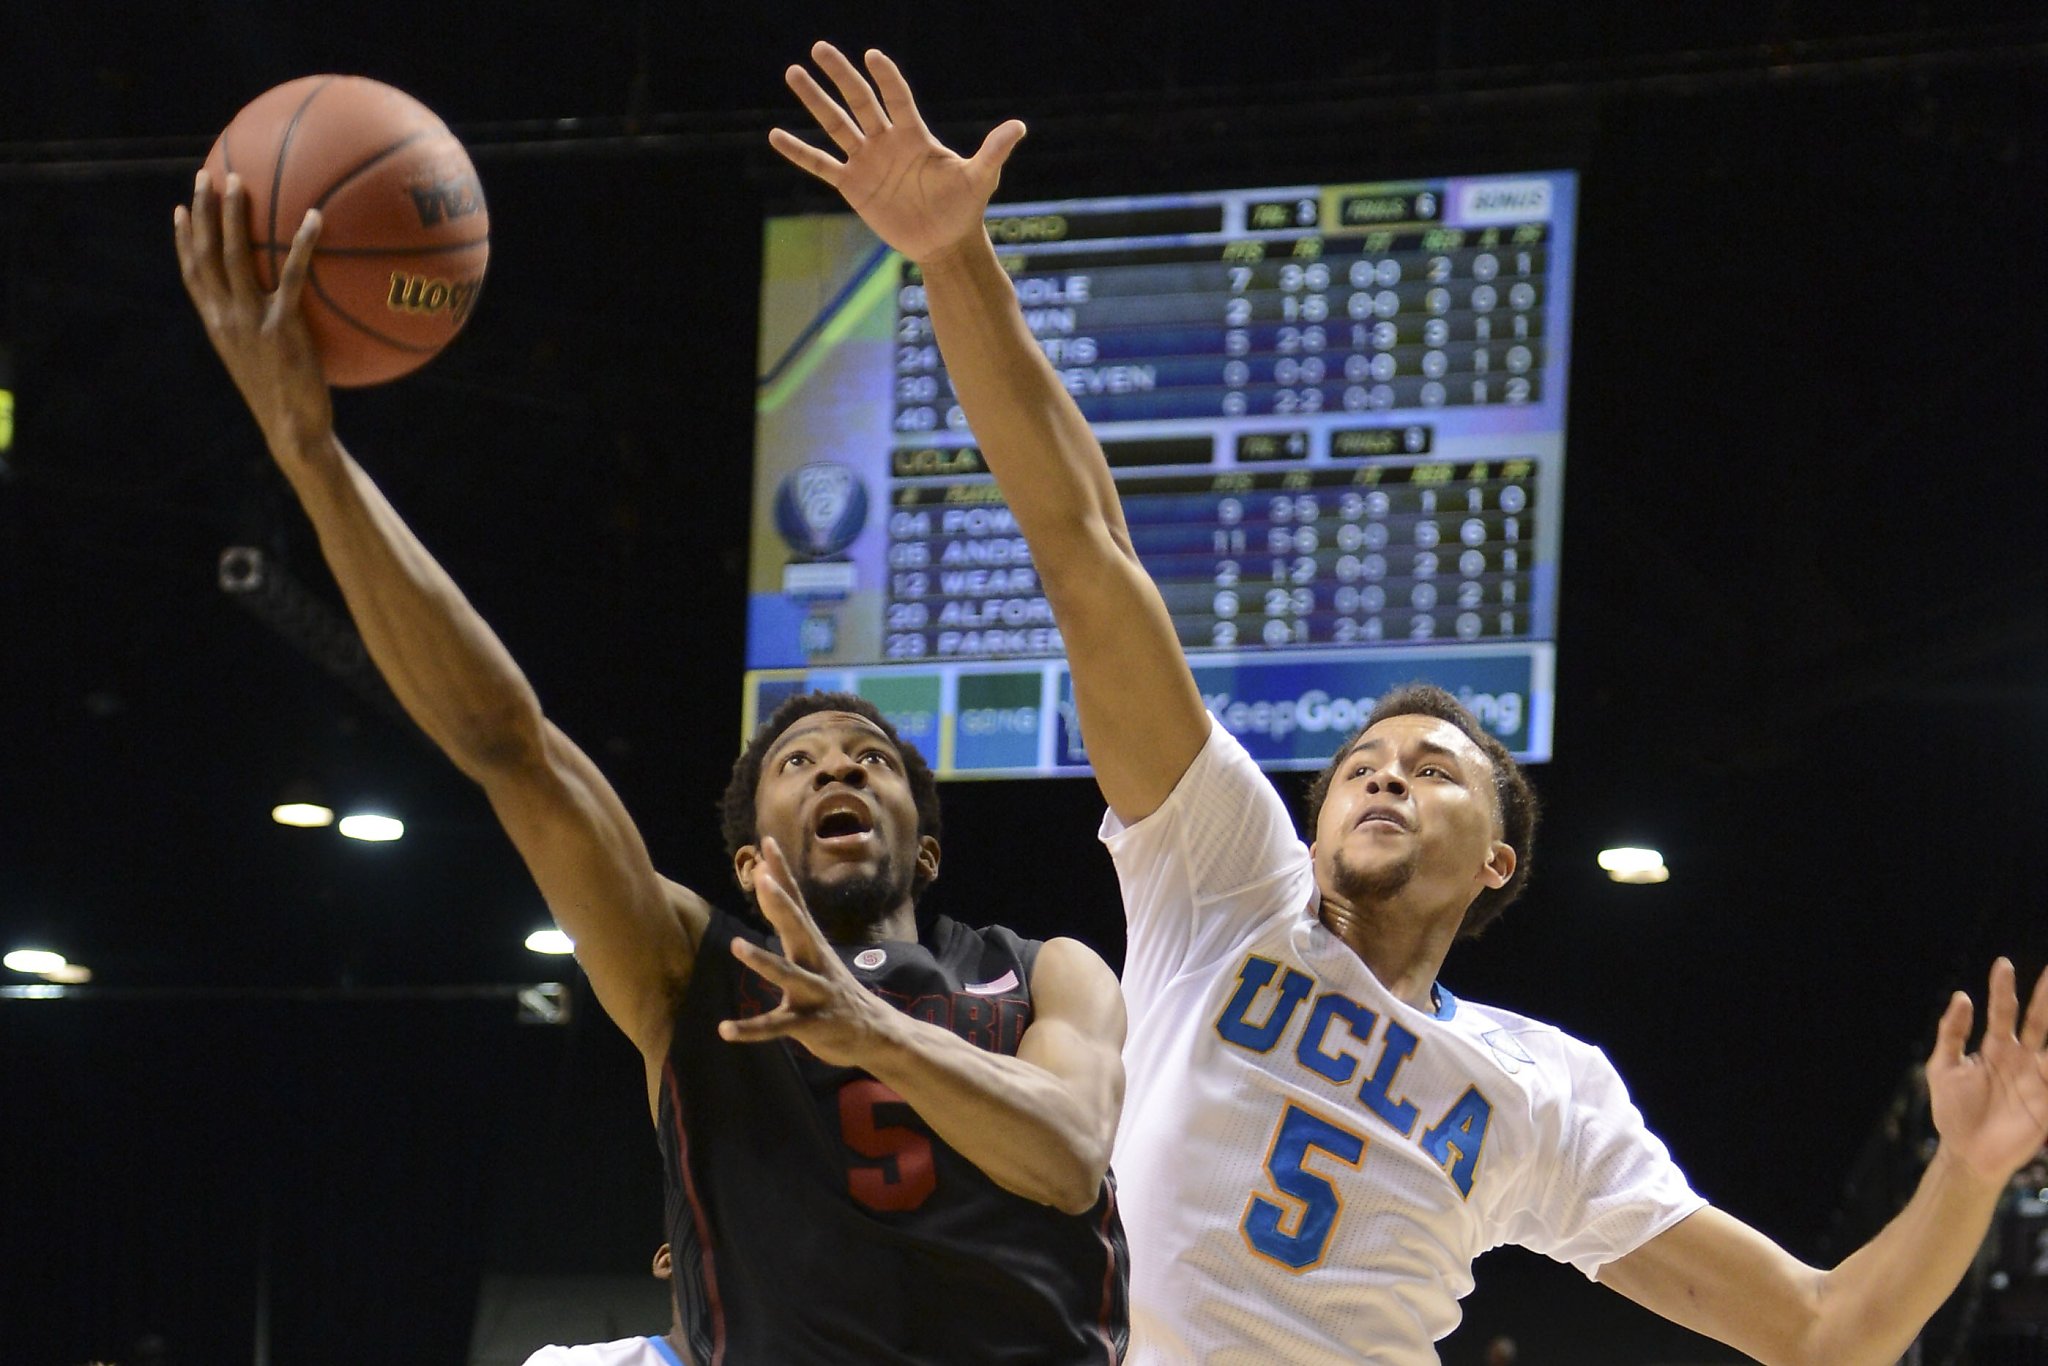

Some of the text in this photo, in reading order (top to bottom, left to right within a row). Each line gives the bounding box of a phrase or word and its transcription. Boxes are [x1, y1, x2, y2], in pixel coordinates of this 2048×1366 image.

[1228, 267, 1253, 293] 7
[1426, 256, 1452, 283] 2
[1473, 253, 1499, 281] 0
[1518, 252, 1531, 276] 1
[1225, 297, 1252, 327] 2
[1472, 285, 1497, 312] 0
[1510, 282, 1535, 311] 0
[1476, 316, 1489, 343] 1
[1515, 314, 1528, 340] 1
[1506, 345, 1532, 374] 0
[1505, 377, 1530, 404] 2
[895, 448, 978, 475] UCLA
[942, 508, 1021, 536] POW
[1420, 489, 1436, 513] 1
[1467, 487, 1483, 512] 1
[1500, 485, 1526, 513] 0
[941, 538, 1033, 566] ANDE
[1504, 517, 1519, 544] 1
[940, 567, 1037, 598] WEAR
[1215, 560, 1241, 586] 2
[1414, 552, 1438, 580] 2
[1459, 549, 1485, 578] 0
[1504, 548, 1517, 575] 1
[937, 597, 1054, 628] ALFOR
[1457, 580, 1483, 609] 2
[1501, 580, 1516, 607] 1
[1213, 621, 1237, 646] 2
[1410, 614, 1435, 640] 2
[1456, 612, 1482, 640] 0
[1500, 611, 1514, 638] 1
[1214, 953, 1494, 1203] UCLA
[838, 1078, 937, 1212] 5
[1238, 1097, 1370, 1276] 5
